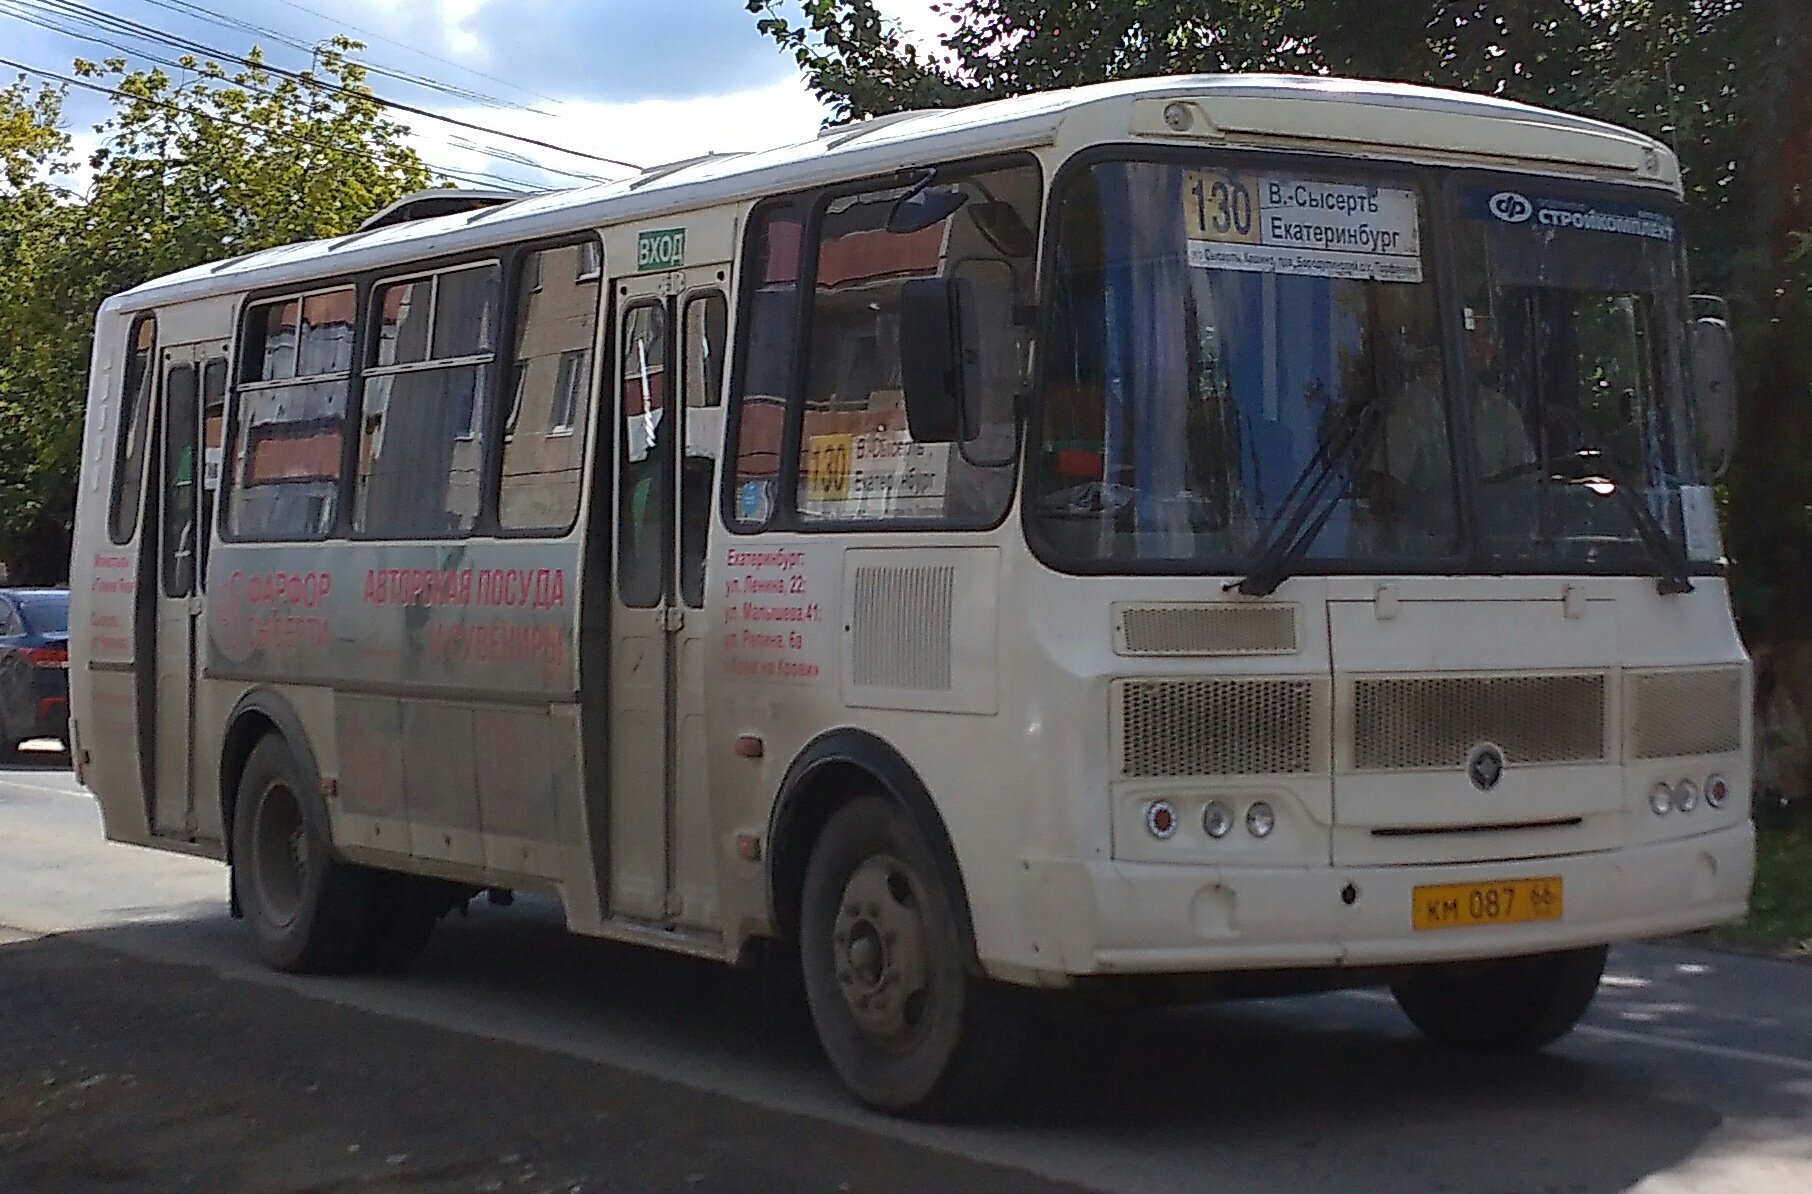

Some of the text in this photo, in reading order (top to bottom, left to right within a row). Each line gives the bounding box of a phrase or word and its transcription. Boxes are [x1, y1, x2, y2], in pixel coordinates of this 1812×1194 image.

[1191, 179, 1251, 235] 130
[1269, 182, 1378, 215] В.-Сысерть
[640, 234, 683, 266] ВХОД
[1270, 216, 1400, 252] Екатеринбург
[812, 444, 846, 492] 130
[245, 571, 331, 609] ФАРФОР
[364, 568, 565, 610] АВТОРСКАЯ ПОСУДА
[1426, 899, 1459, 922] КМ
[1469, 887, 1515, 919] 087
